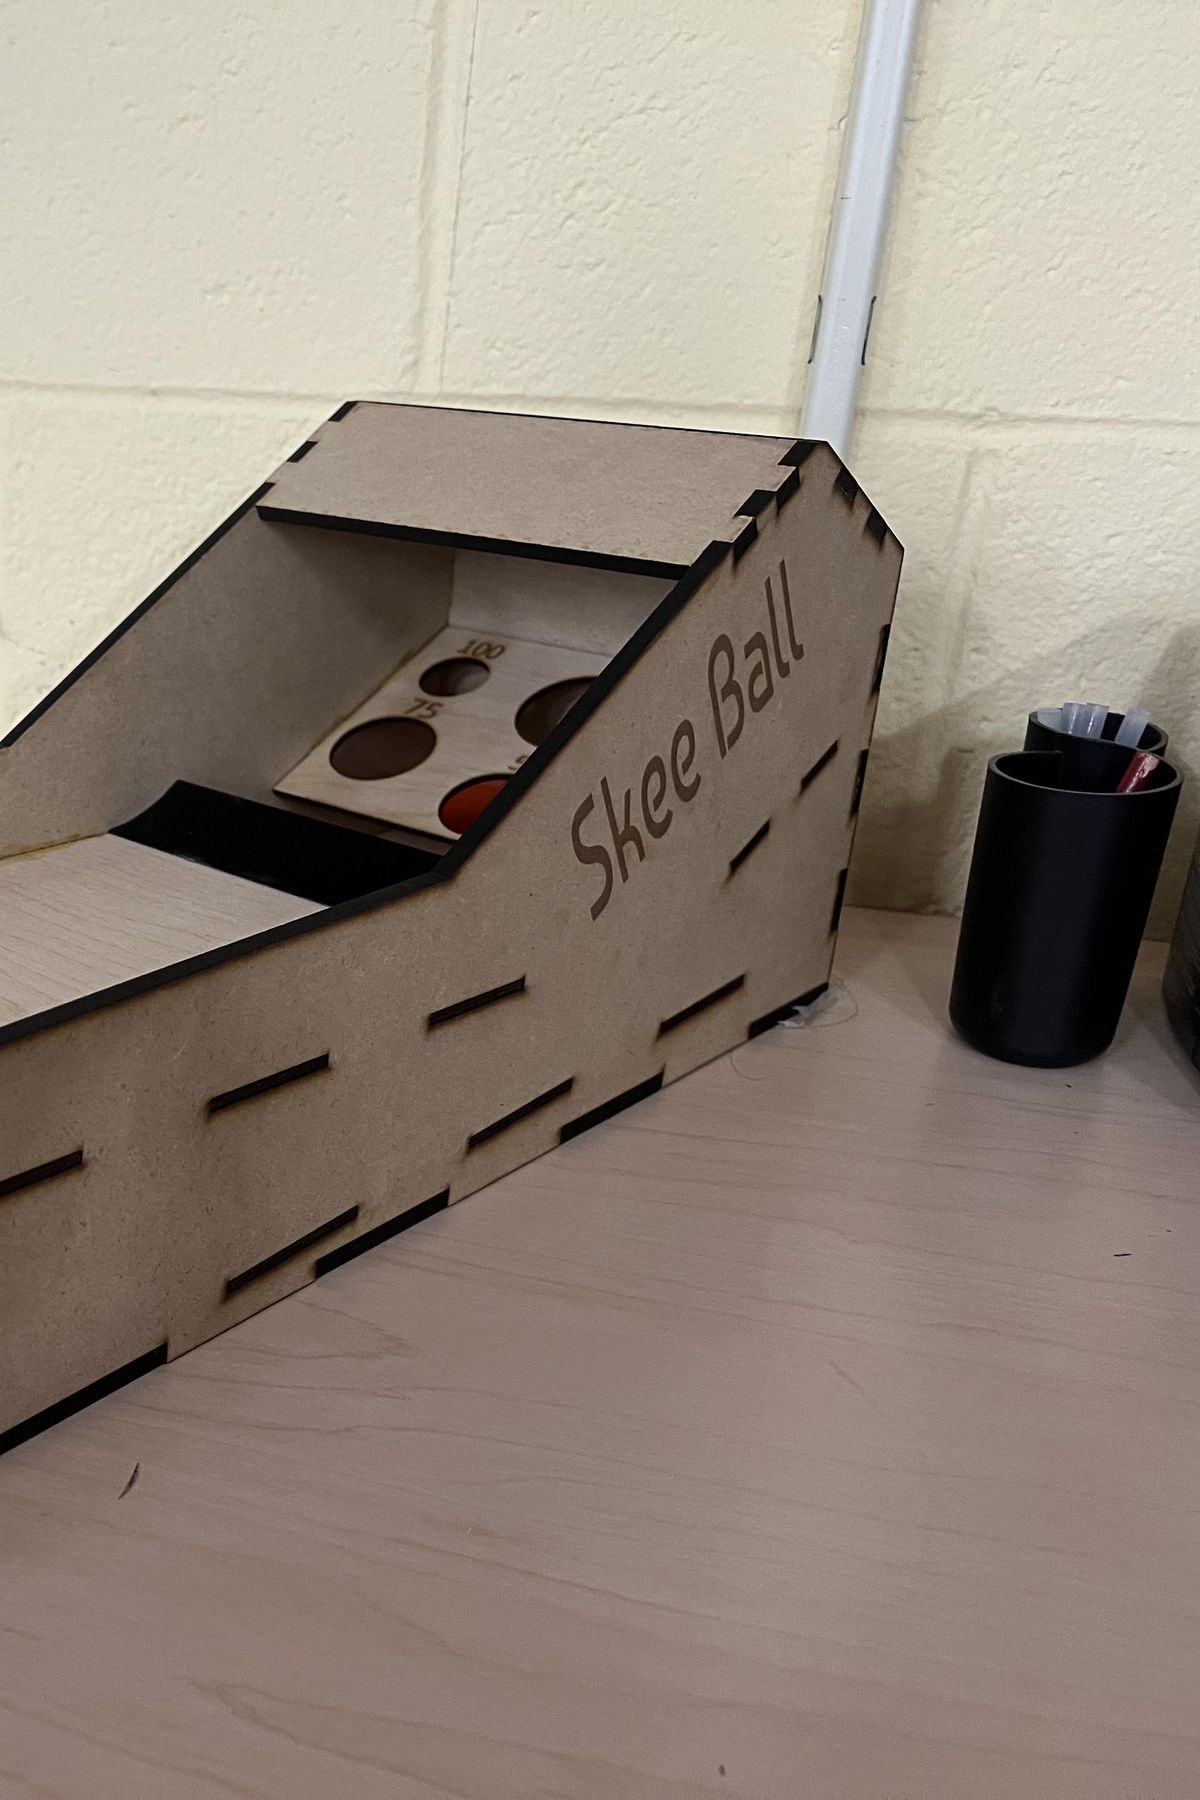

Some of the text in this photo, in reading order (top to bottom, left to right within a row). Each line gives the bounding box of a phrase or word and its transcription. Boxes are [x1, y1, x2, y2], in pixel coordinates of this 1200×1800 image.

[456, 640, 506, 660] 100
[403, 697, 444, 719] 75
[571, 558, 805, 922] Skee Ball
